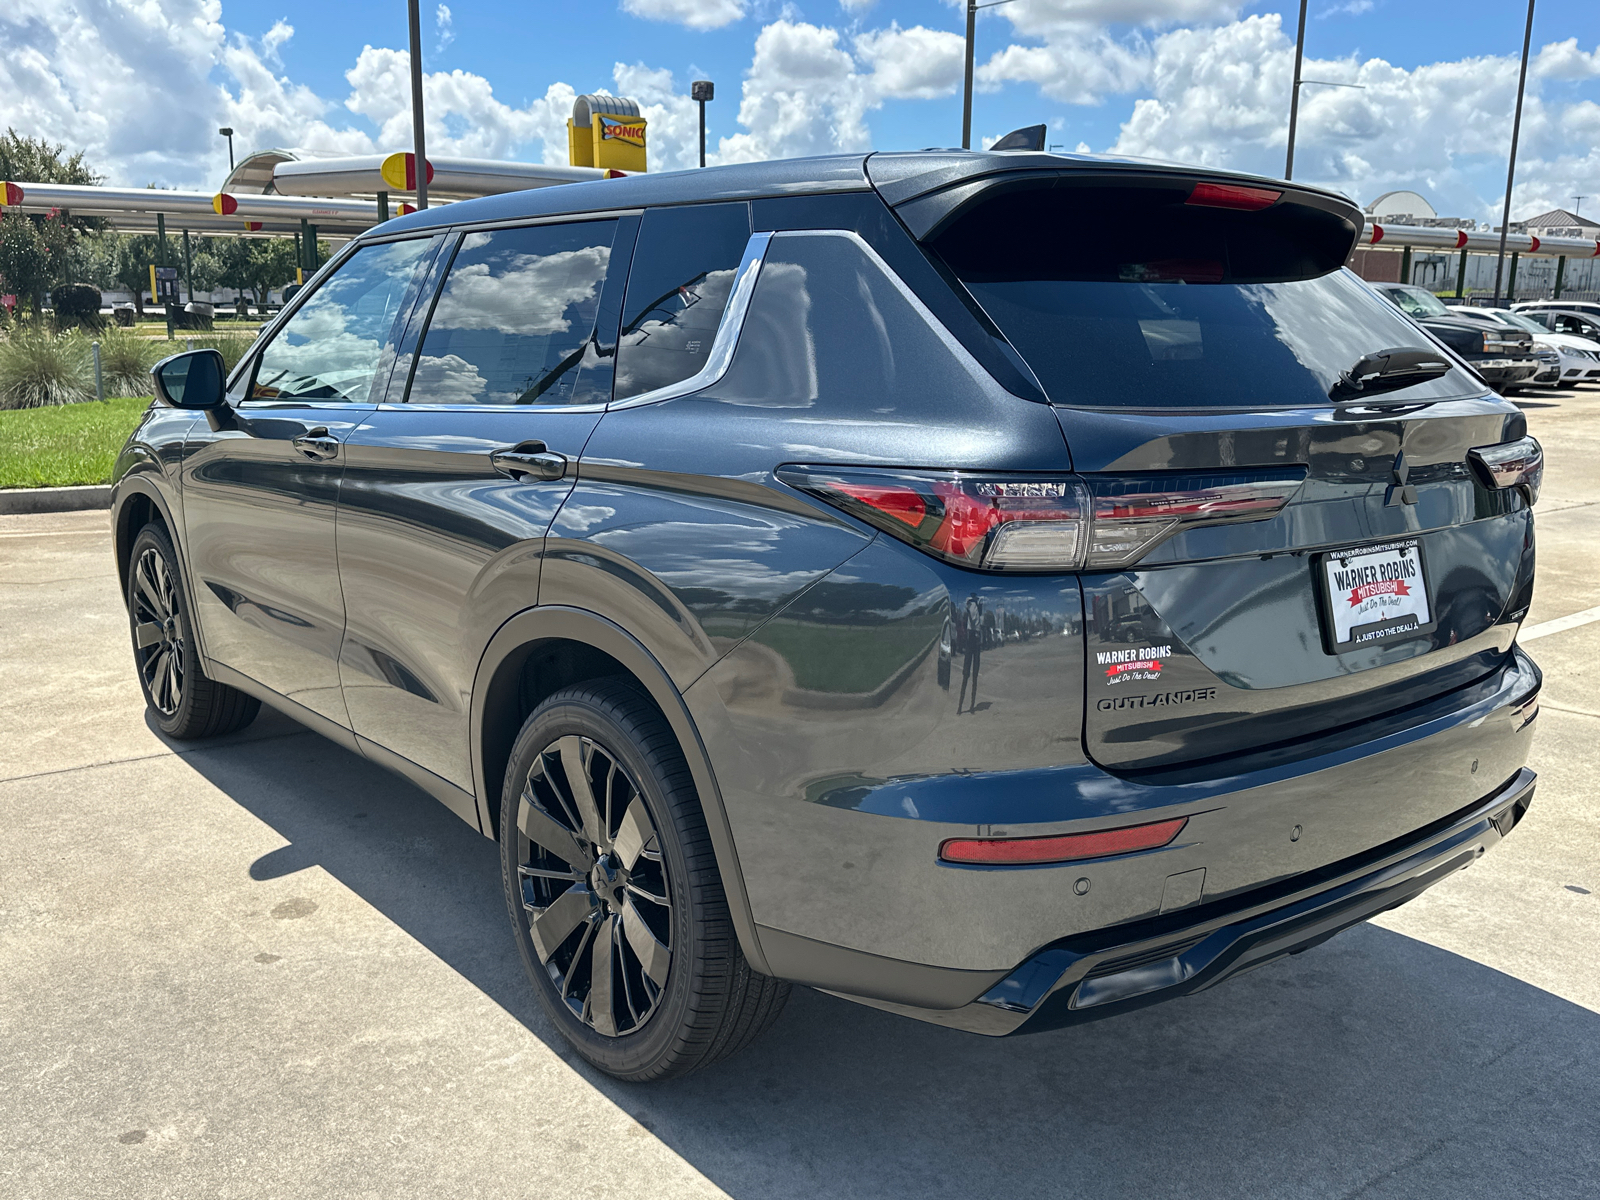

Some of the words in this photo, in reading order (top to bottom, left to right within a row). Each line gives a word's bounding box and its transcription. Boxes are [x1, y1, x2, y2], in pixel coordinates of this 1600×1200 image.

[606, 125, 643, 138] SONIC
[1334, 565, 1377, 591] WARNER
[1379, 558, 1416, 580] ROBINS
[1357, 581, 1398, 599] MITSUBISHI
[1358, 602, 1369, 615] Just
[1370, 599, 1378, 608] Do
[1379, 597, 1387, 607] The
[1361, 633, 1375, 642] JUST
[1376, 631, 1384, 639] DO
[1384, 627, 1396, 637] THE
[1397, 624, 1413, 634] DEAL!
[1097, 649, 1136, 664] WARNER
[1139, 645, 1172, 660] ROBINS
[1116, 661, 1153, 672] MITSUBISHI
[1107, 676, 1121, 686] Just
[1122, 674, 1130, 682] Do
[1131, 671, 1142, 680] The
[1097, 687, 1217, 711] OUTLANDER
